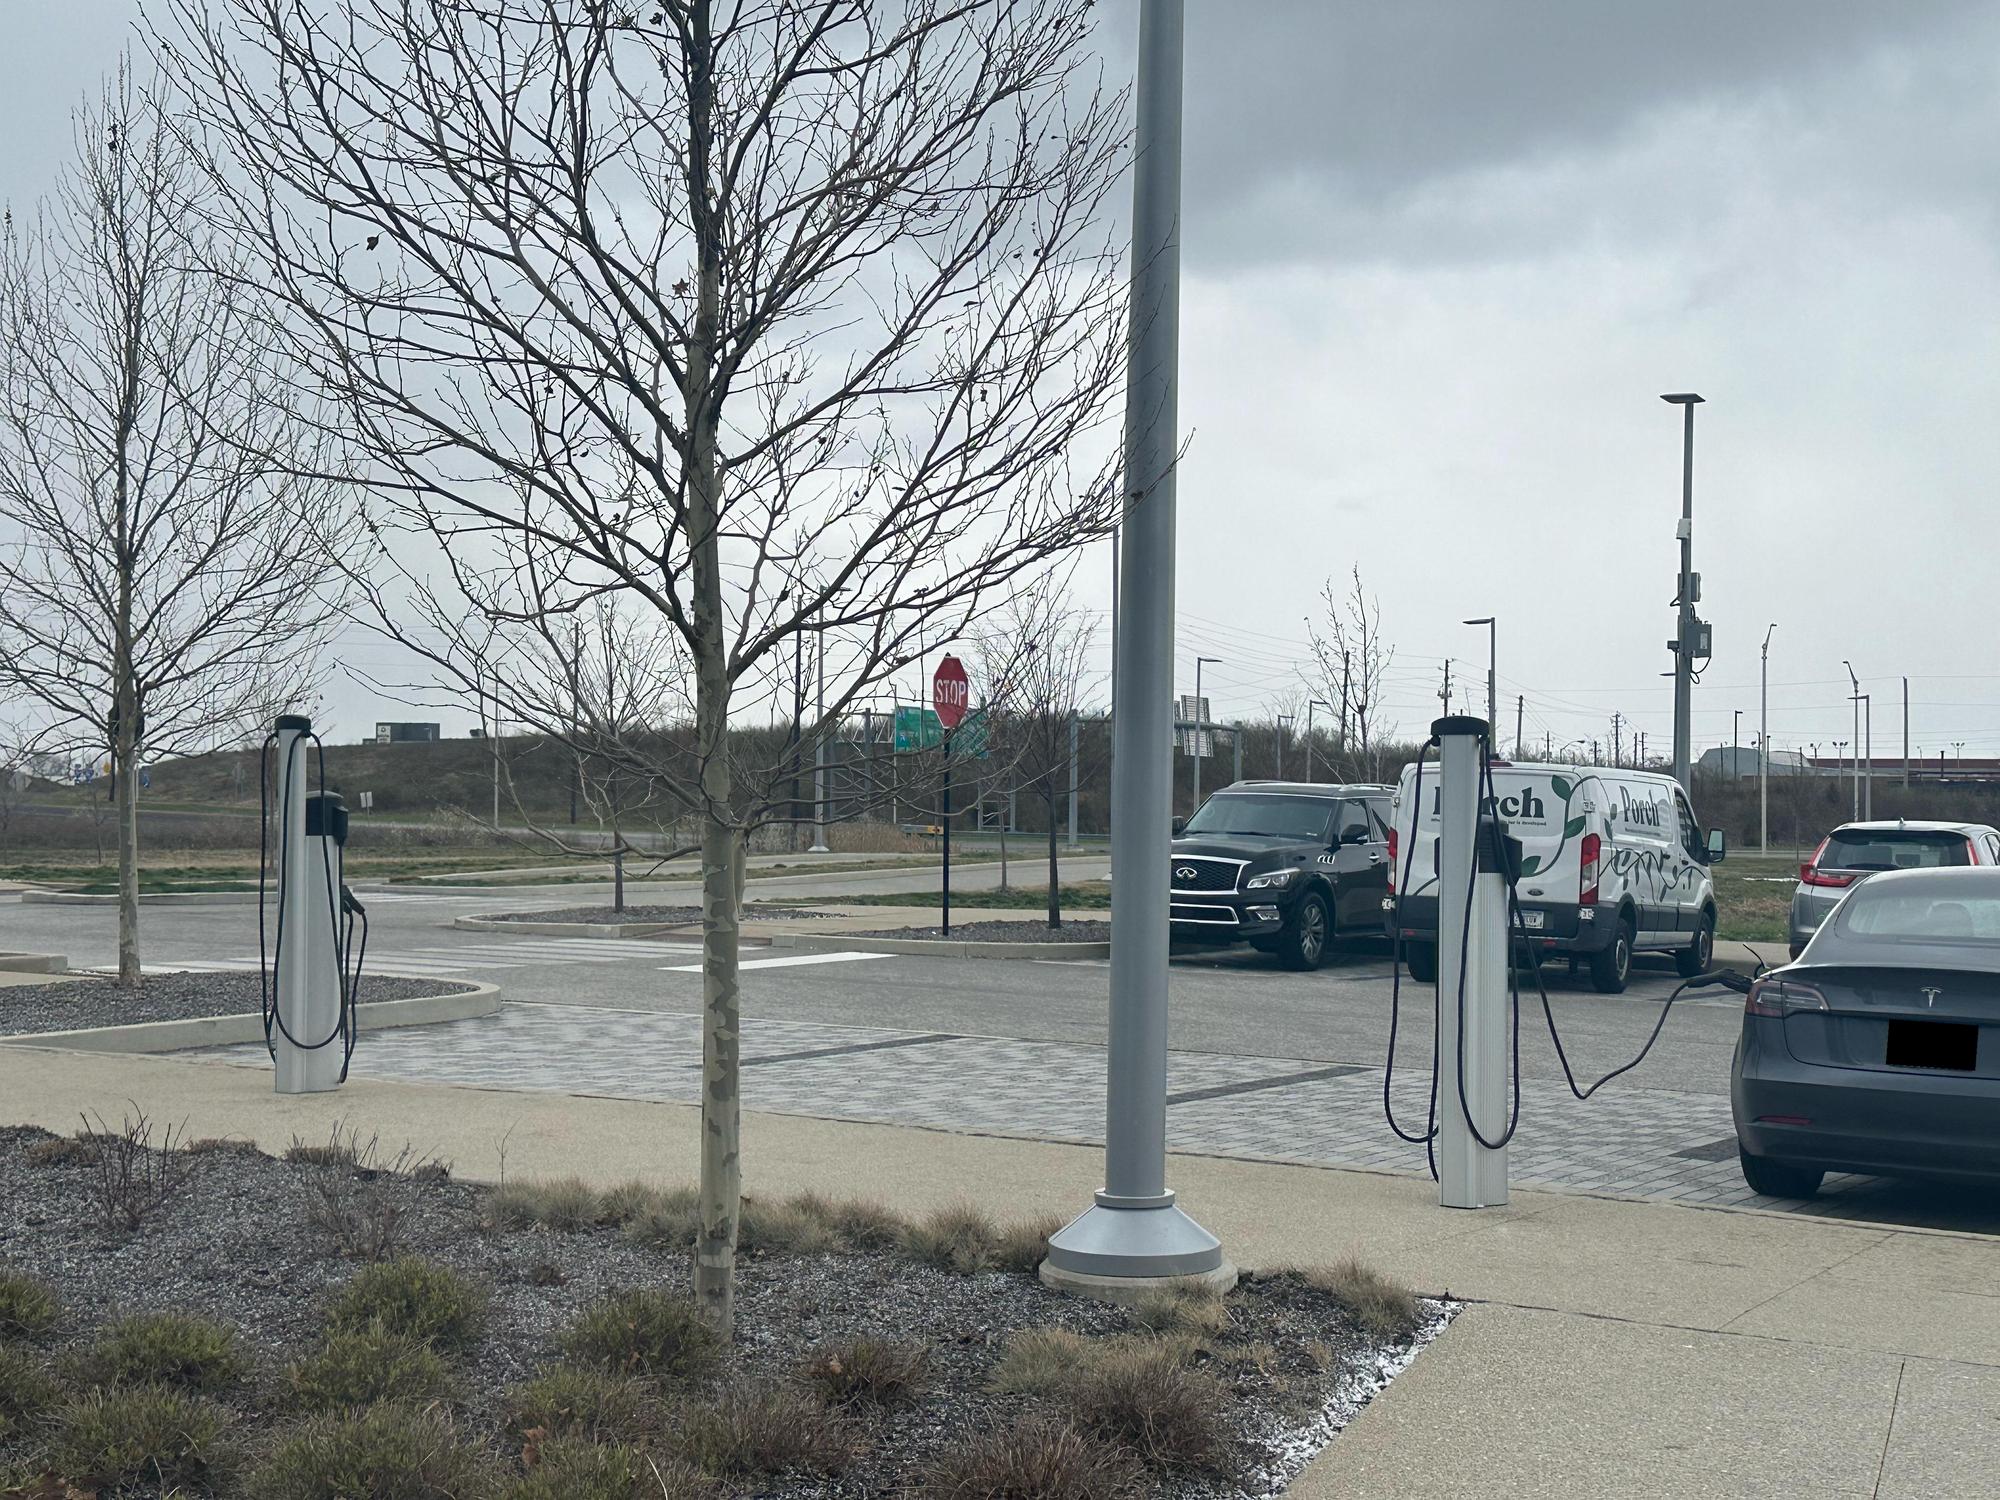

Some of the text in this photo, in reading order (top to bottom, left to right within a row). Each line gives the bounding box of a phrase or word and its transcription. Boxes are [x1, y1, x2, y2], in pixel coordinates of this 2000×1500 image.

[936, 679, 966, 707] STOP
[1433, 786, 1545, 819] rch
[1619, 785, 1660, 827] Porch
